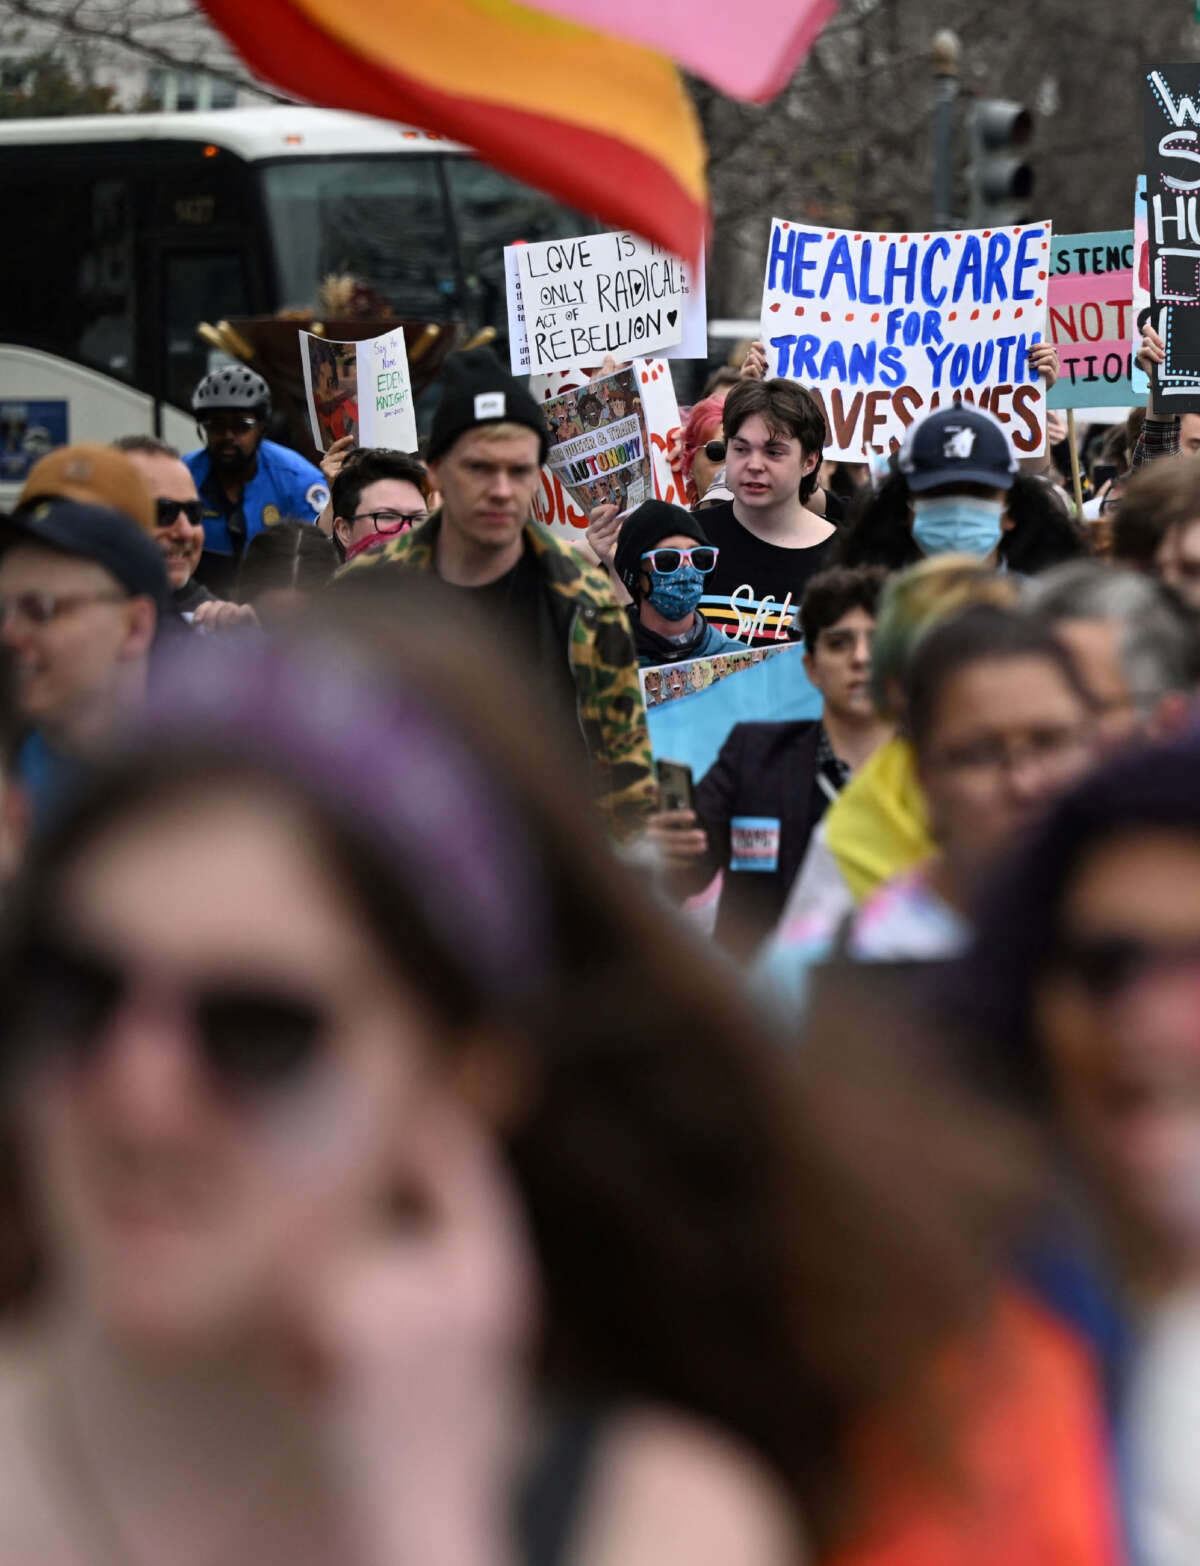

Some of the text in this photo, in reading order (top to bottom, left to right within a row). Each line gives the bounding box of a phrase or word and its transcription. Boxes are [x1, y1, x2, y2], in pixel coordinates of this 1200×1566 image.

[527, 241, 592, 278] LOVE
[616, 235, 636, 261] IS
[768, 225, 1045, 308] HEALHCARE
[1049, 244, 1134, 278] STENC
[540, 280, 585, 306] ONLY
[596, 258, 681, 313] RADICAL
[535, 308, 580, 330] ACT OF
[535, 309, 661, 365] REBELLION
[886, 308, 944, 346] FOR
[1048, 300, 1133, 344] NOT
[770, 331, 1042, 388] TRANS YOUTH
[1062, 353, 1132, 386] TIO
[375, 389, 409, 411] KNIGHT
[377, 371, 404, 392] EDEN
[563, 436, 598, 458] QUEER
[597, 431, 608, 445] &
[607, 418, 638, 442] TRANS
[569, 436, 641, 483] AUTONOMY
